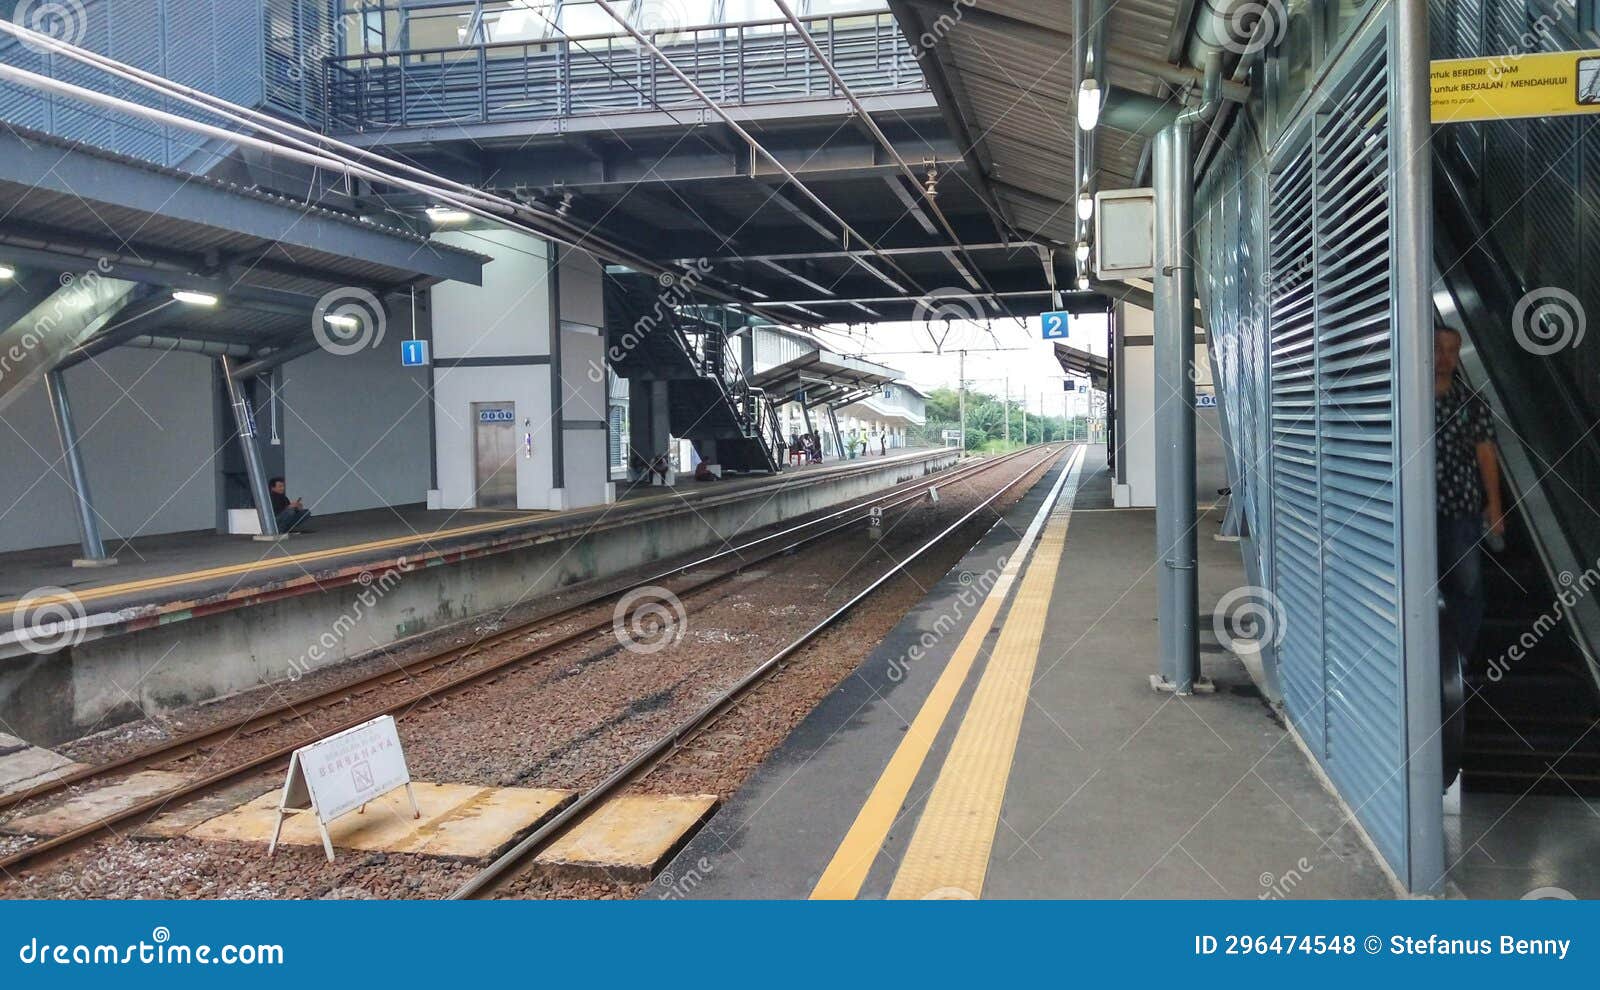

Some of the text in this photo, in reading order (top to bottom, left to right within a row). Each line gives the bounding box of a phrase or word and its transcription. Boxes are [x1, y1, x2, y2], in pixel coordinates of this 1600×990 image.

[1430, 70, 1450, 79] ntuk
[1452, 68, 1486, 78] BERDIRI
[1434, 84, 1458, 93] untuk
[1461, 81, 1503, 91] BERJALAN
[1511, 77, 1567, 88] MENDAHULUI
[1048, 316, 1062, 336] 2
[409, 344, 415, 362] 1
[871, 517, 880, 527] 32
